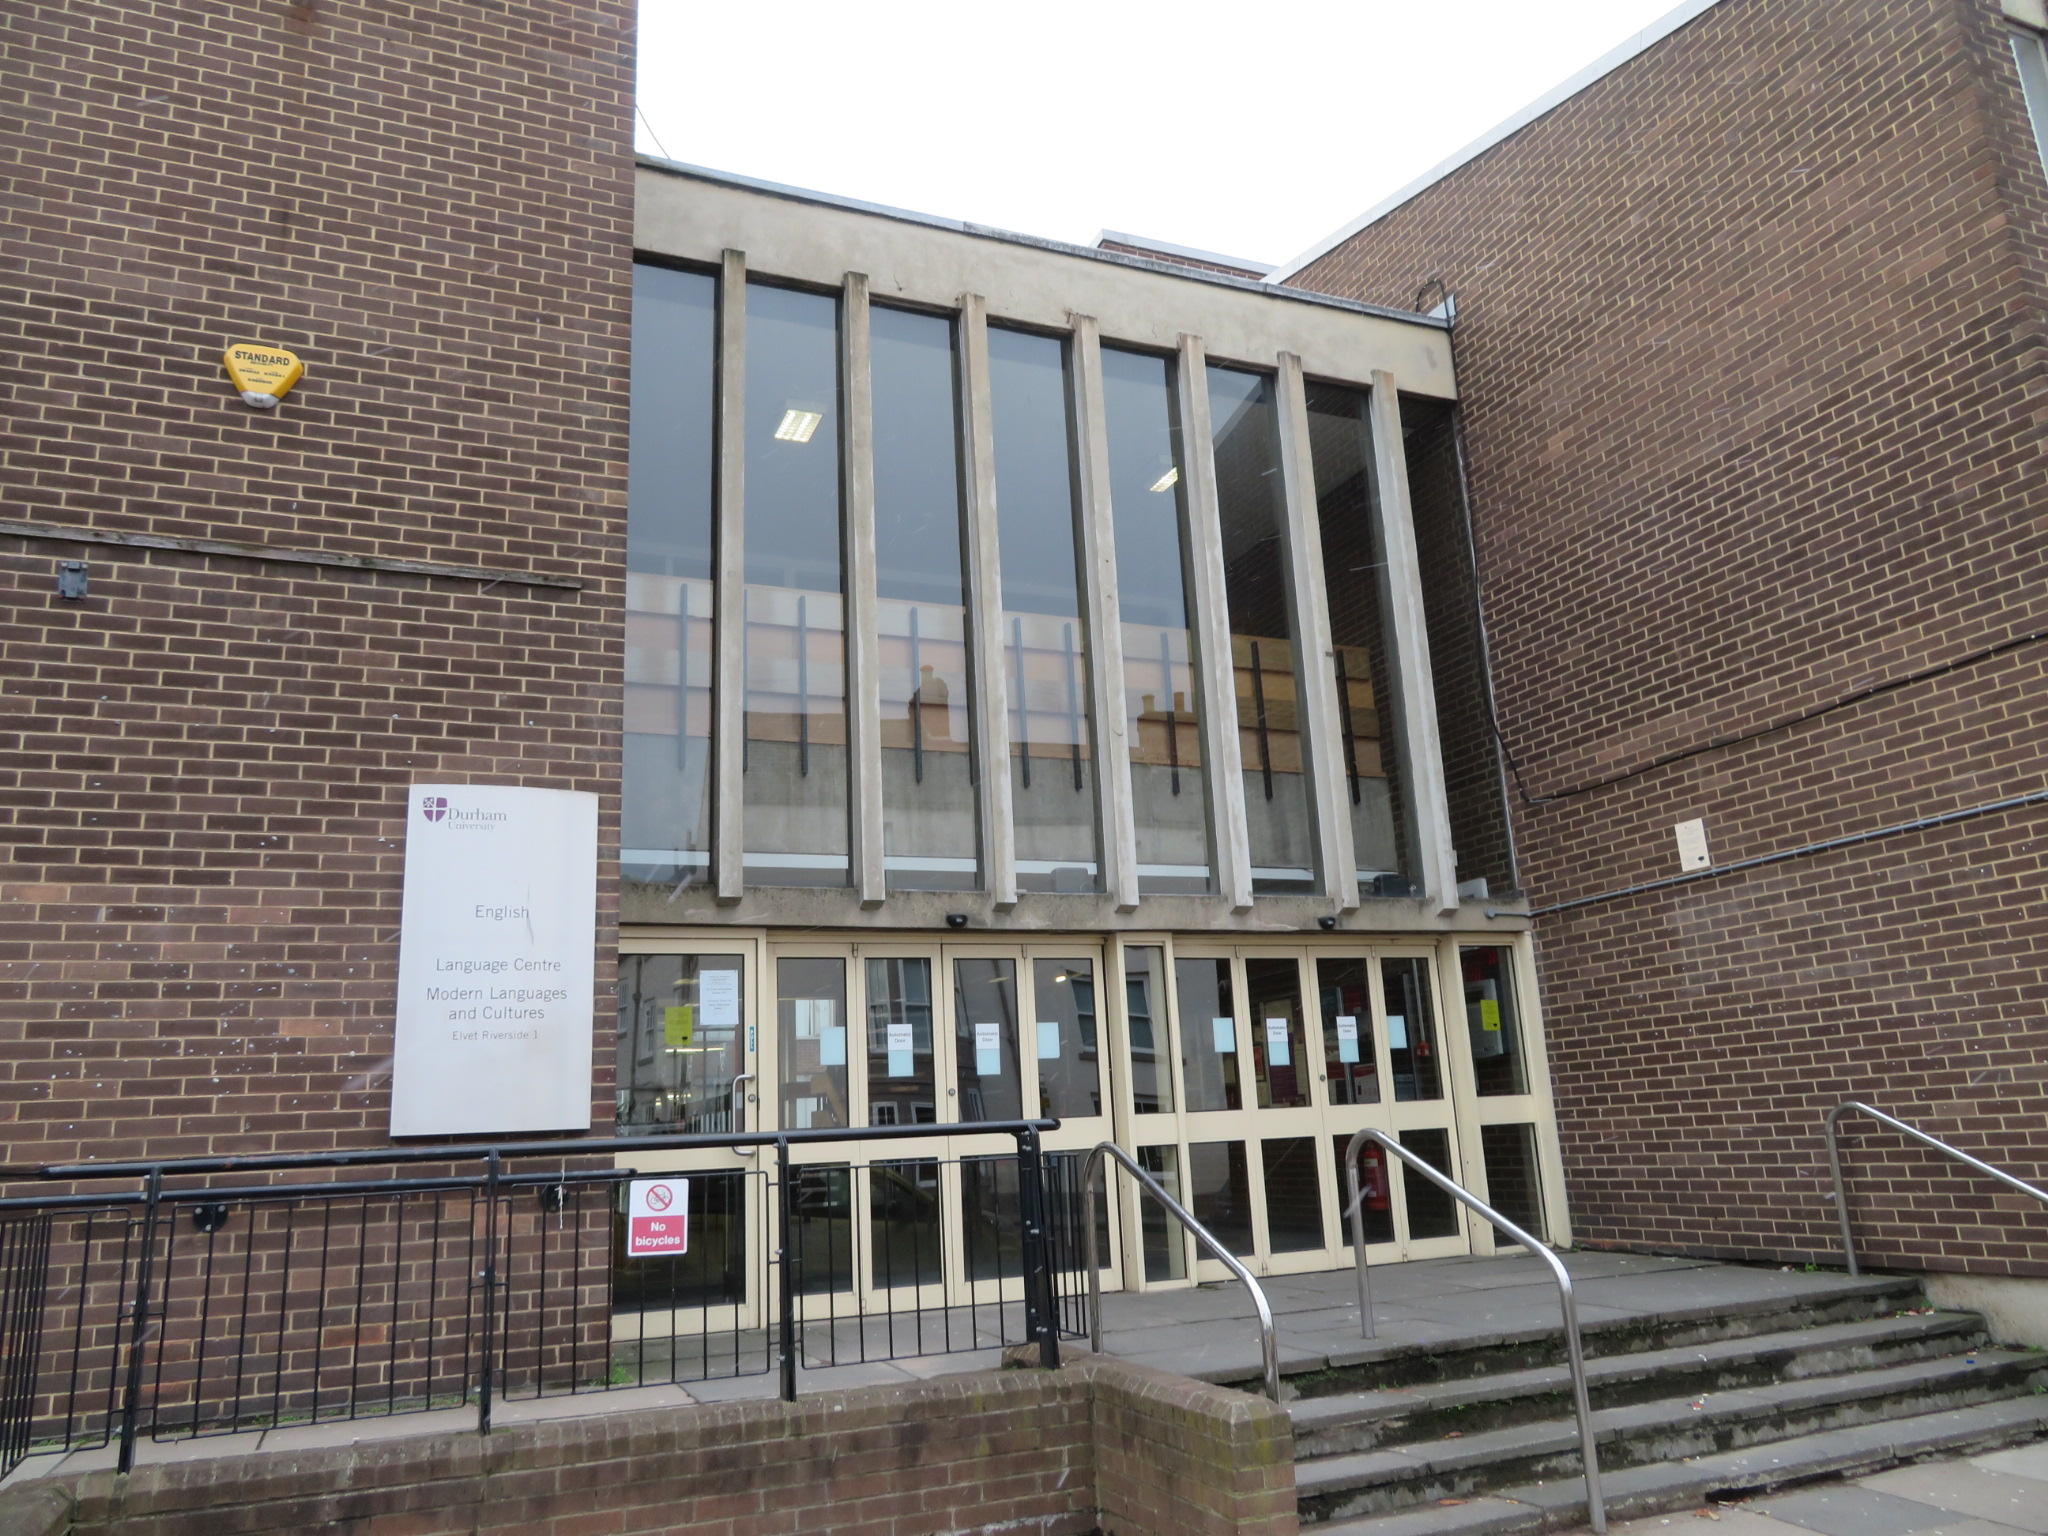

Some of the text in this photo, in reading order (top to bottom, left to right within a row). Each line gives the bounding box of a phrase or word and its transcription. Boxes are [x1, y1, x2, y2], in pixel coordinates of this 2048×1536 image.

[235, 350, 290, 366] STANDARD
[448, 807, 507, 821] Durham
[448, 821, 496, 831] University
[475, 905, 530, 921] English
[436, 958, 562, 974] Language Centre
[426, 986, 568, 1002] Modern Languages
[448, 1005, 545, 1020] and Cultures
[452, 1029, 539, 1041] Elvet Riverside 1
[650, 1222, 666, 1232] No
[635, 1234, 681, 1248] bicycles
